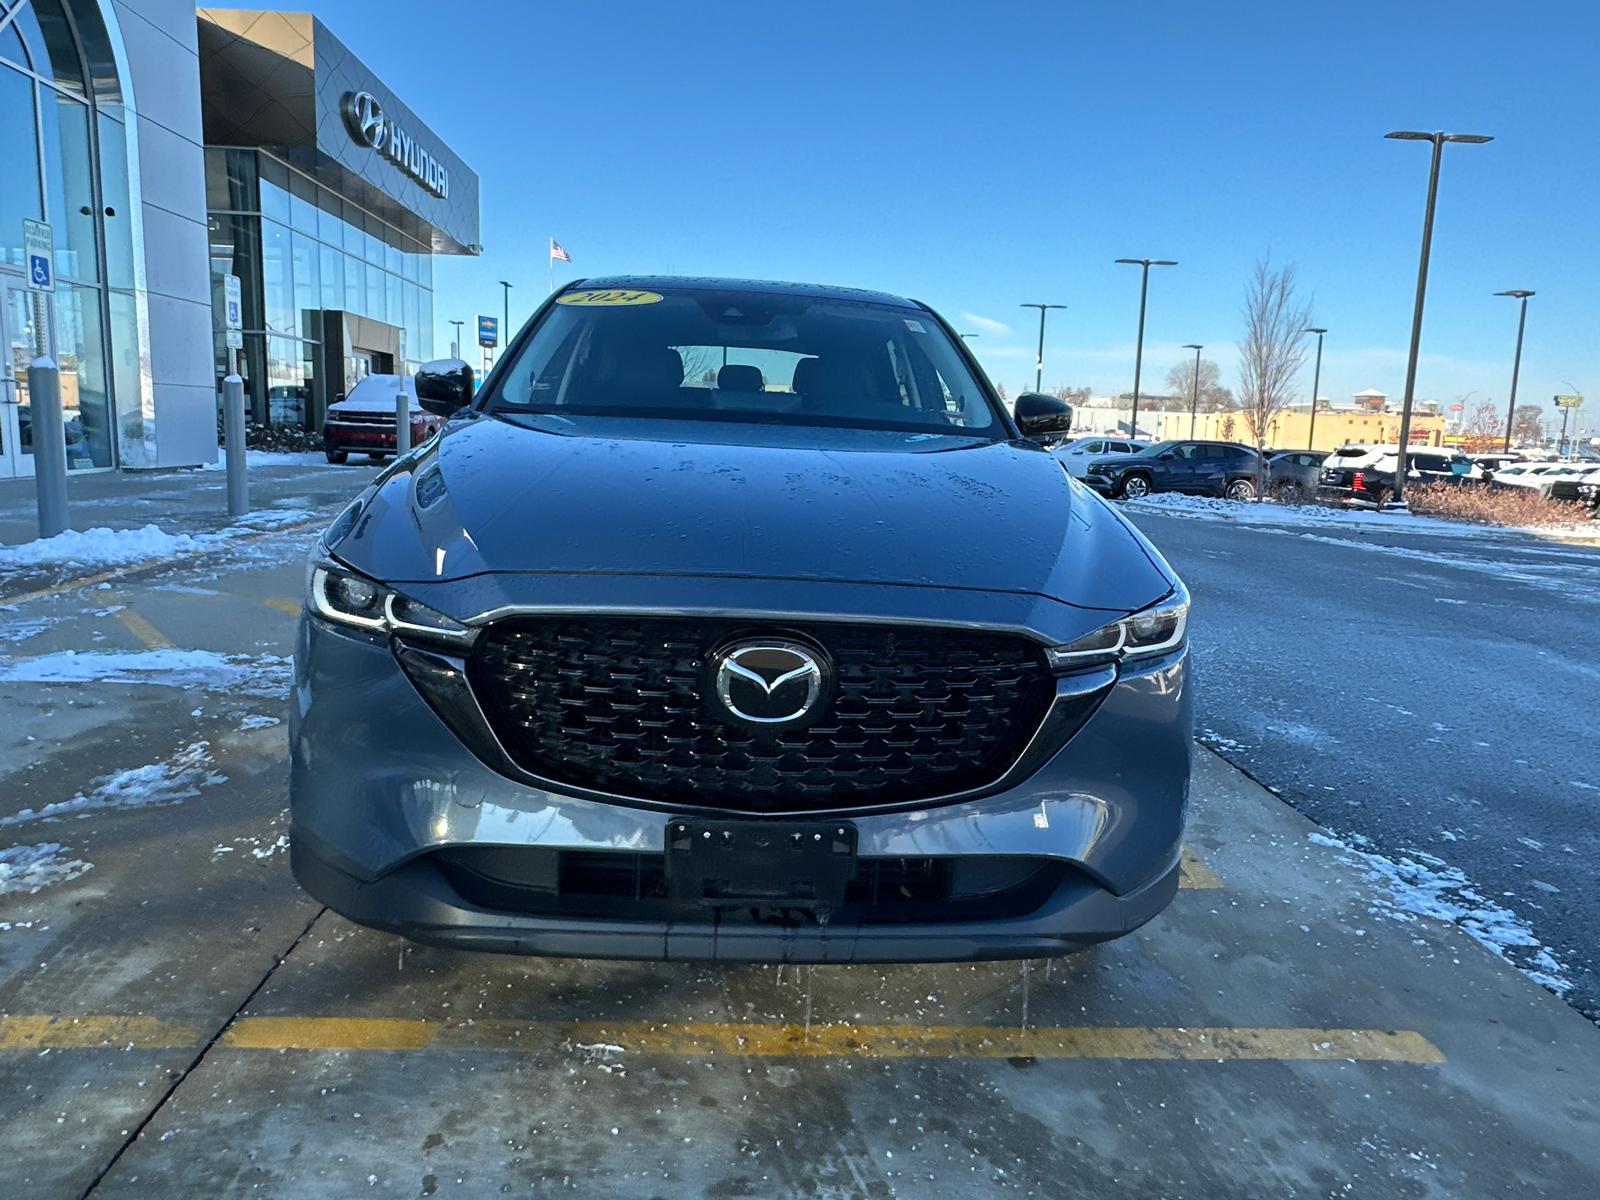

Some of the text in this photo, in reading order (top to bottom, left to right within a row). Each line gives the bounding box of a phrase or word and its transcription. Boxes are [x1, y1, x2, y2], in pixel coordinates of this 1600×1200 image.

[391, 121, 448, 199] HYUNDAI
[27, 236, 52, 252] PARKING
[567, 292, 648, 303] 2024
